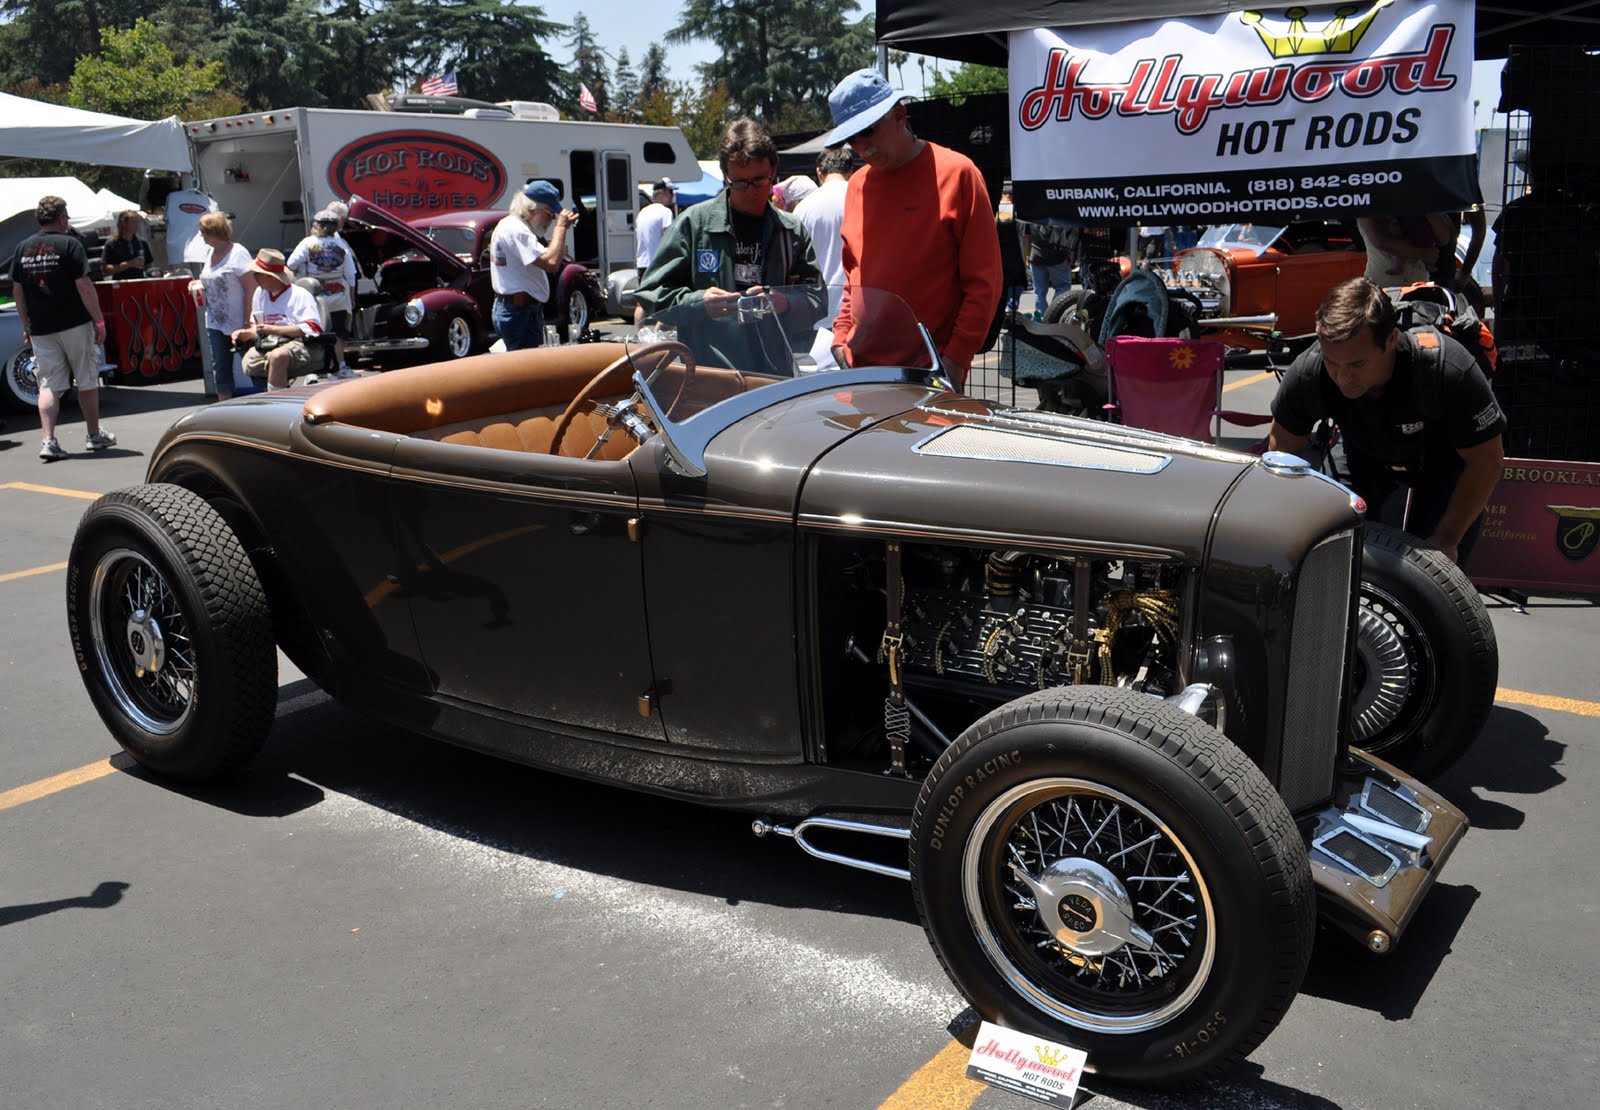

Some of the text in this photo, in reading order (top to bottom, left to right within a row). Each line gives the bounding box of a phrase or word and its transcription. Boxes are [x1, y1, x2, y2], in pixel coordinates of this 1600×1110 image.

[1019, 23, 1458, 136] Hollywood
[1216, 107, 1422, 157] HOT RODS
[351, 148, 490, 181] HOT RODS
[373, 189, 478, 208] HOBBIES
[1045, 170, 1403, 201] BURBANK, CALIFORNIA. (818) 842-6900
[1077, 192, 1371, 218] WWW.HOLLYWOODHOTRODS.COM
[1503, 467, 1600, 486] BROOKLA
[1482, 528, 1537, 541] California
[930, 750, 1021, 851] DUNLOP RACING
[976, 1039, 1078, 1082] Hollywood
[1022, 1071, 1041, 1083] HOT
[1040, 1077, 1065, 1091] RODS
